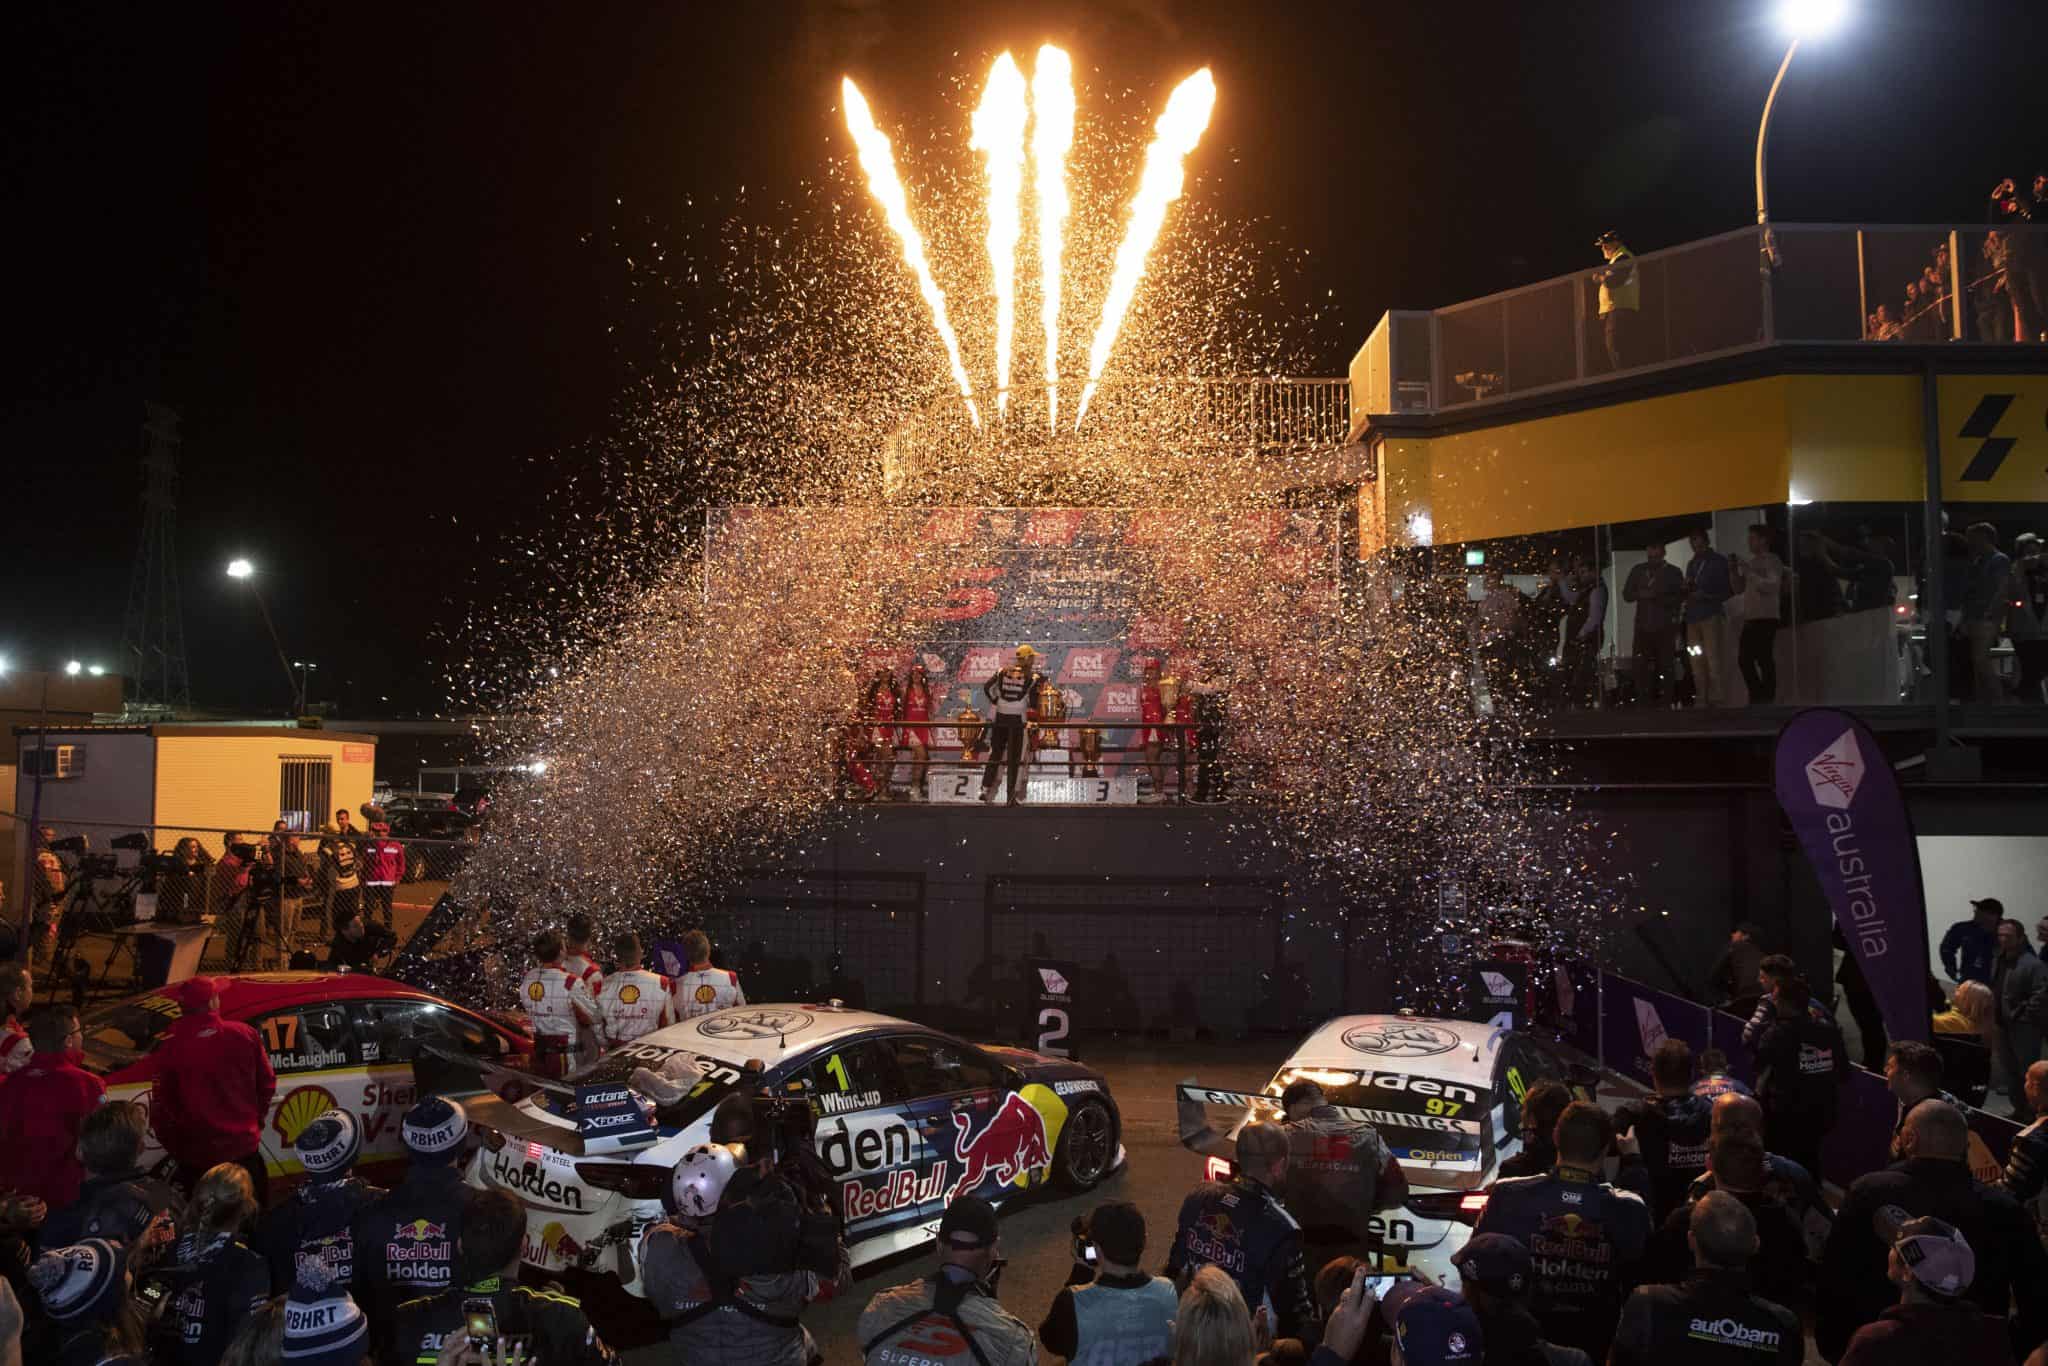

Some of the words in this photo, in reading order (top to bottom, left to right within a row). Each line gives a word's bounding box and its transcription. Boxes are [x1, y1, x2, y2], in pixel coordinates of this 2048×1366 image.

[970, 652, 999, 669] red
[1072, 653, 1104, 670] red
[1107, 688, 1137, 705] red
[955, 776, 969, 796] 2
[1812, 754, 1855, 798] Virgin
[1096, 781, 1109, 801] 3
[1826, 813, 1888, 957] australia
[261, 1015, 298, 1050] 17
[1038, 1009, 1069, 1056] 2
[270, 1050, 346, 1068] McLaughlin
[609, 1043, 742, 1085] Holen
[826, 1053, 849, 1090] 1
[363, 1083, 415, 1105] Shel
[585, 1091, 629, 1104] octane
[1425, 1099, 1462, 1117] 97
[1360, 1109, 1467, 1134] WINGS
[411, 1127, 454, 1146] RBHRT
[821, 1117, 911, 1172] den
[304, 1142, 346, 1165] RBHRT
[494, 1152, 581, 1209] Holden
[387, 1262, 450, 1279] Holden
[287, 1306, 337, 1330] RBHRT
